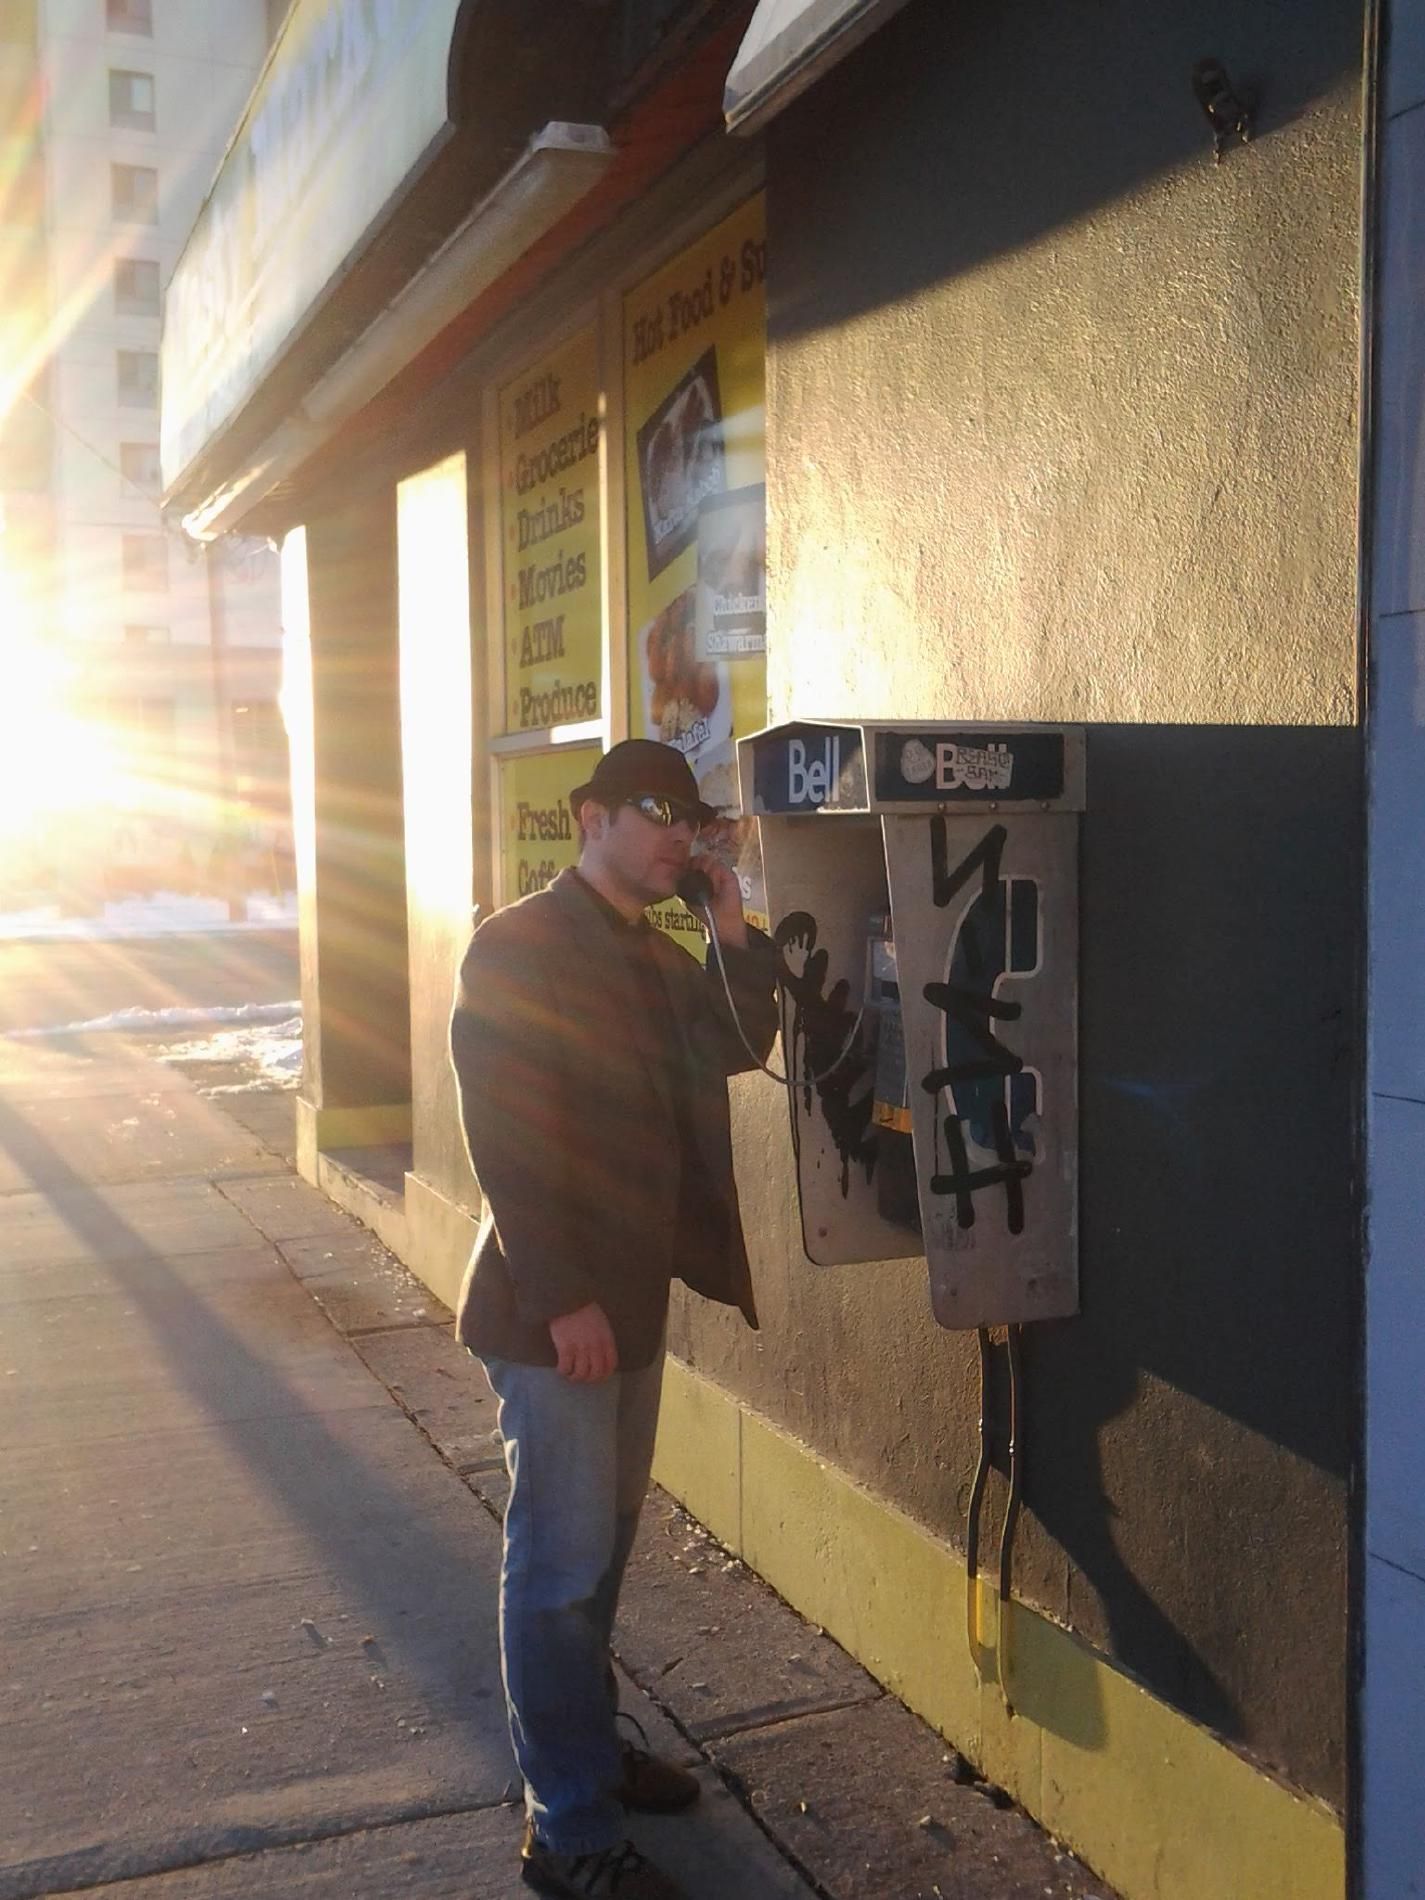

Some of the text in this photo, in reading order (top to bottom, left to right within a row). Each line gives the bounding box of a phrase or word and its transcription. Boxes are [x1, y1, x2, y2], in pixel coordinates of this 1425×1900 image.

[668, 267, 714, 342] Food
[720, 254, 736, 306] &
[515, 411, 600, 495] Grocerie
[517, 487, 585, 552] Drinks
[517, 549, 586, 611] Movies
[519, 614, 566, 669] ATM
[519, 680, 597, 727] Produce
[788, 737, 840, 804] Bell
[517, 799, 571, 841] Fresh
[518, 857, 560, 898] Coff
